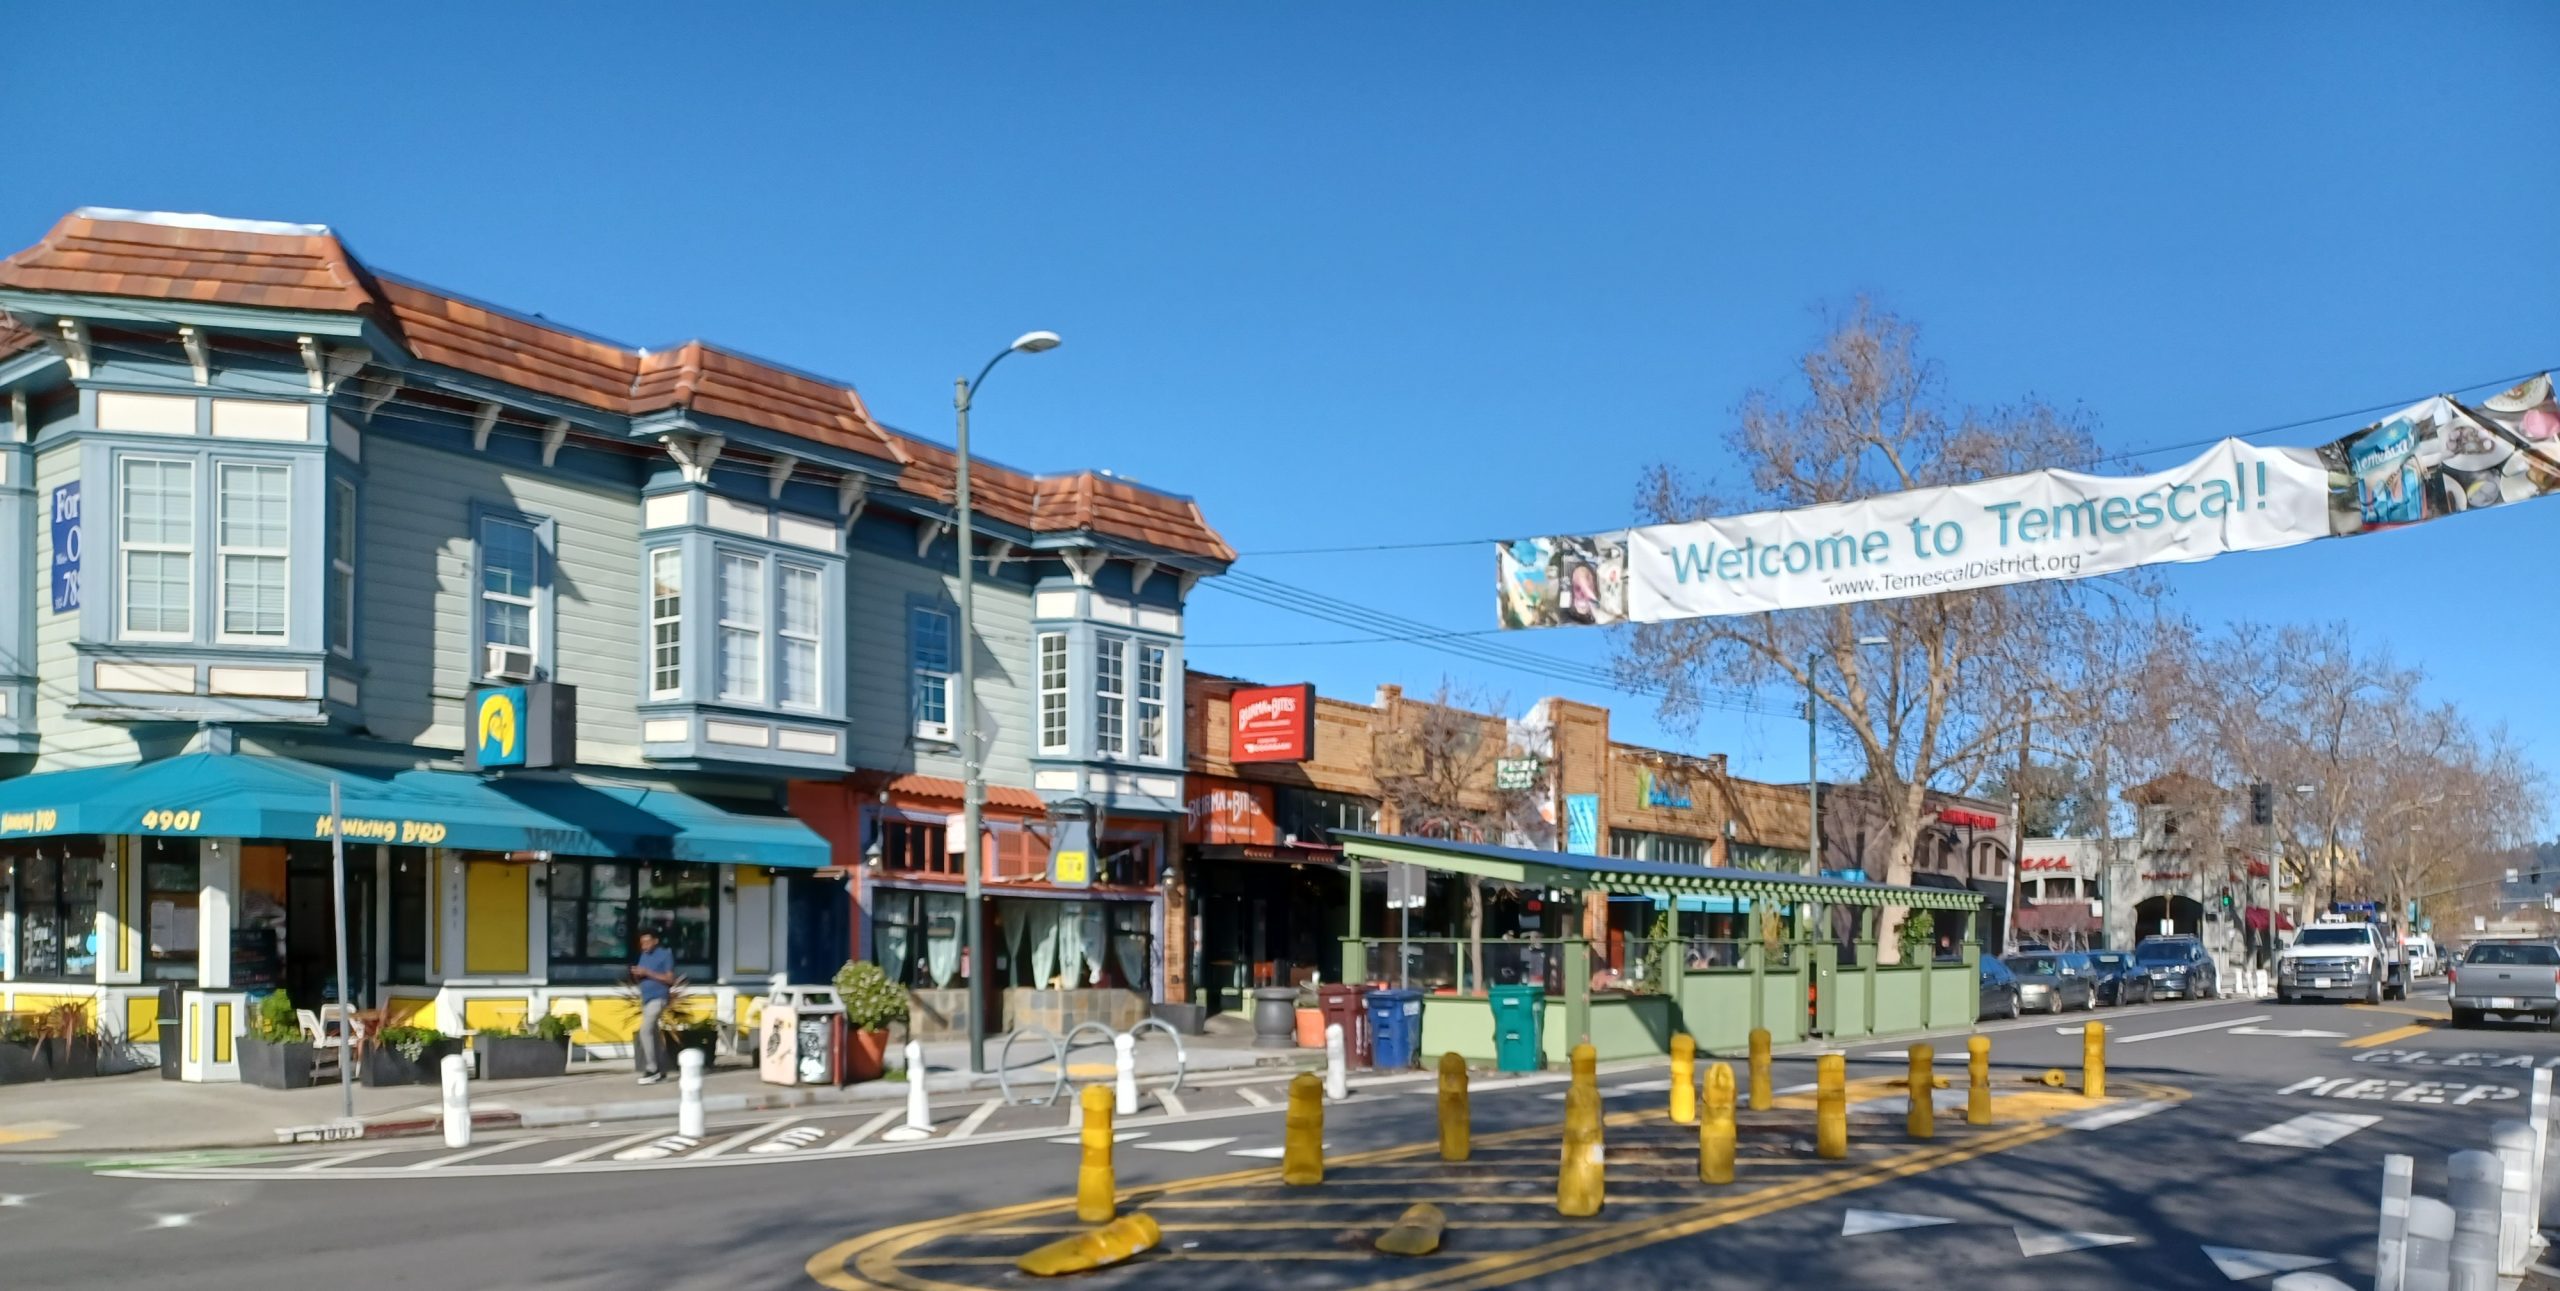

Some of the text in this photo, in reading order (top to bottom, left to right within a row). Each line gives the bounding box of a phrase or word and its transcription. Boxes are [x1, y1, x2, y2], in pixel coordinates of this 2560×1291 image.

[1671, 461, 2267, 584] Welcome to Temescal!
[1828, 553, 2081, 596] www.TemescalDistrict.org
[142, 809, 201, 832] 4901
[316, 814, 446, 844] HWKING BIRD
[2278, 1076, 2520, 1105] KEEP
